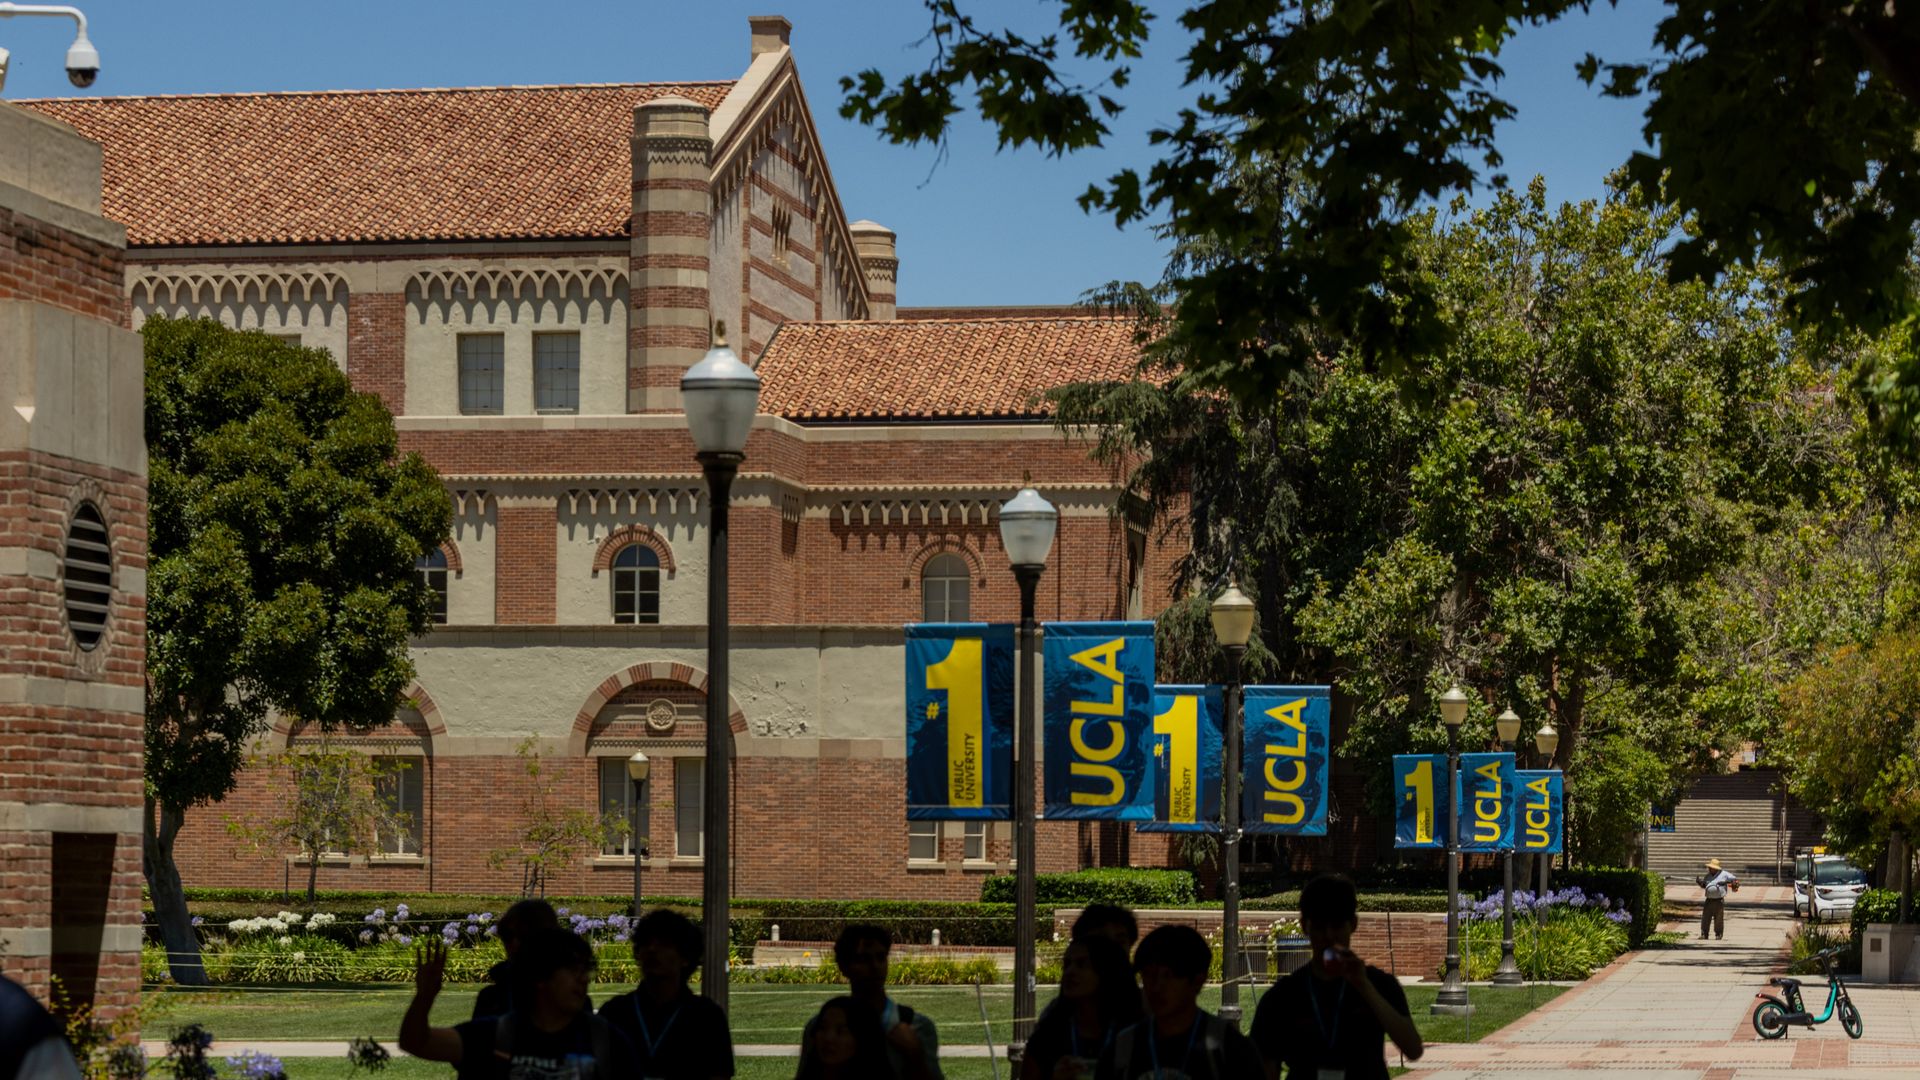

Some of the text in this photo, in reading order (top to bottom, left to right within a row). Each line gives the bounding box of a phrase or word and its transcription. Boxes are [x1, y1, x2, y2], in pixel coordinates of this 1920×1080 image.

[1069, 636, 1126, 807] UCLA
[954, 760, 964, 800] PUBLIC
[964, 733, 975, 801] UNIVERSITY
[1182, 767, 1192, 818] UNIVERSITY
[1263, 697, 1308, 825] UCLA
[1174, 787, 1183, 818] PUBLIC
[1474, 760, 1502, 842] UCLA
[1525, 776, 1550, 849] UCLA
